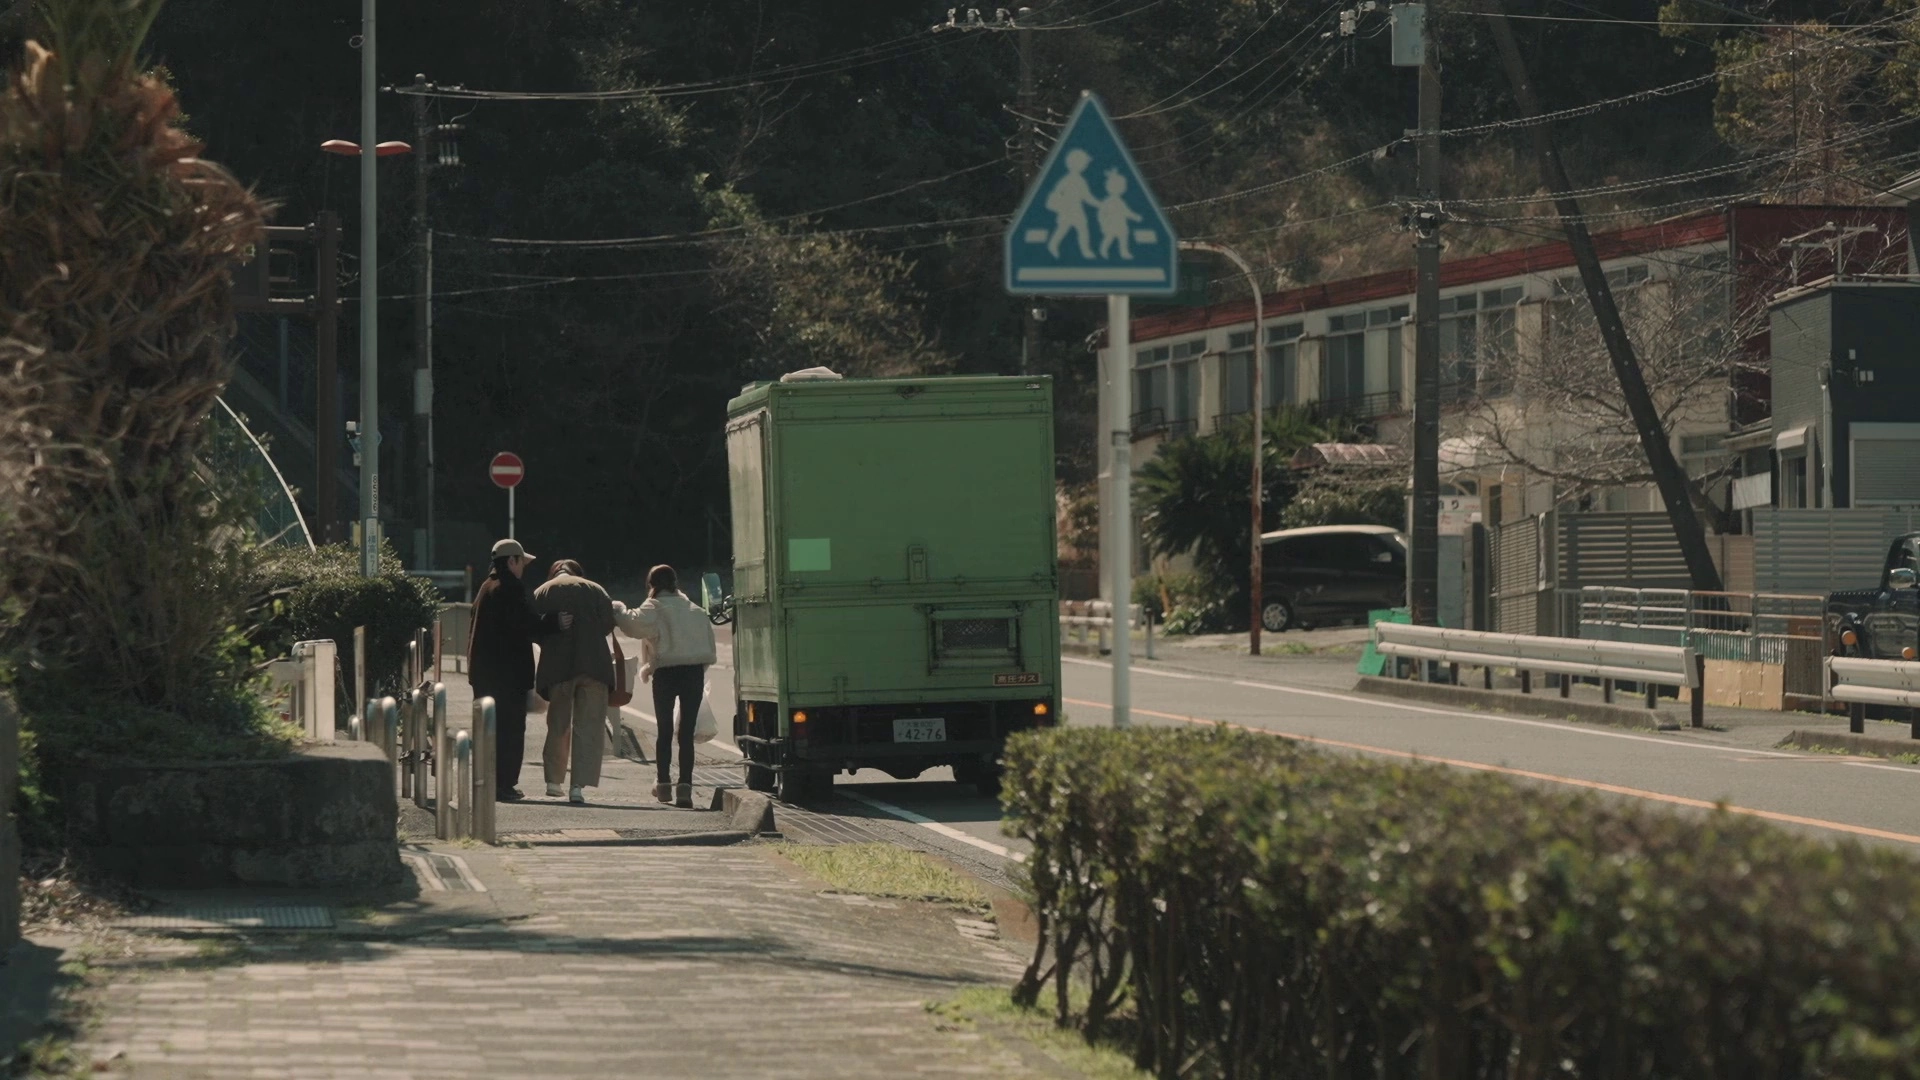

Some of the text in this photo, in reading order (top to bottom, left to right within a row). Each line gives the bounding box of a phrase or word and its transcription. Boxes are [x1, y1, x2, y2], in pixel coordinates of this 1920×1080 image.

[997, 674, 1036, 684] 高圧ガス
[905, 728, 942, 740] 42-76
